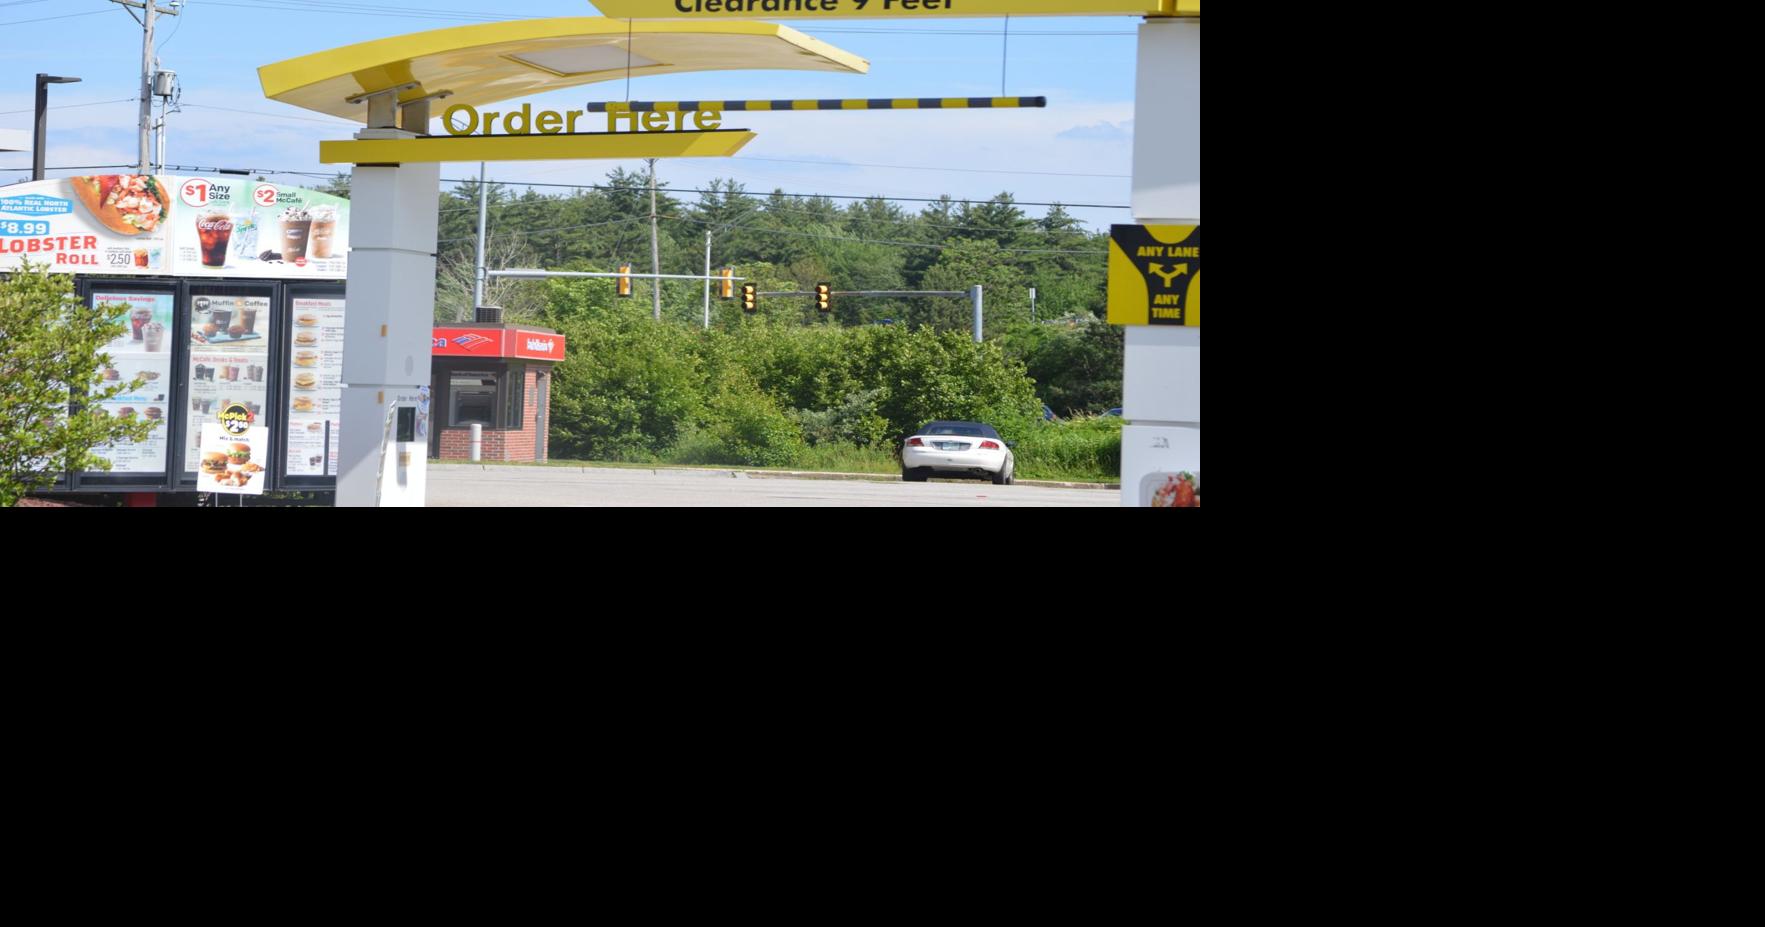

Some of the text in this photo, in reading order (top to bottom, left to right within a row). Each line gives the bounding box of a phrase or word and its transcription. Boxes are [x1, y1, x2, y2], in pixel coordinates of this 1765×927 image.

[674, 0, 838, 12] Clearance
[442, 101, 722, 135] Order Here
[185, 183, 231, 202] $1 Any
[209, 192, 231, 200] Size
[256, 189, 275, 202] $2
[0, 221, 47, 234] $8.99
[0, 235, 97, 254] LOBSTER
[1137, 245, 1200, 258] ANY LANE
[56, 252, 98, 265] ROLL
[1153, 294, 1180, 305] ANY
[1151, 307, 1181, 318] TIME
[217, 411, 247, 420] McPick
